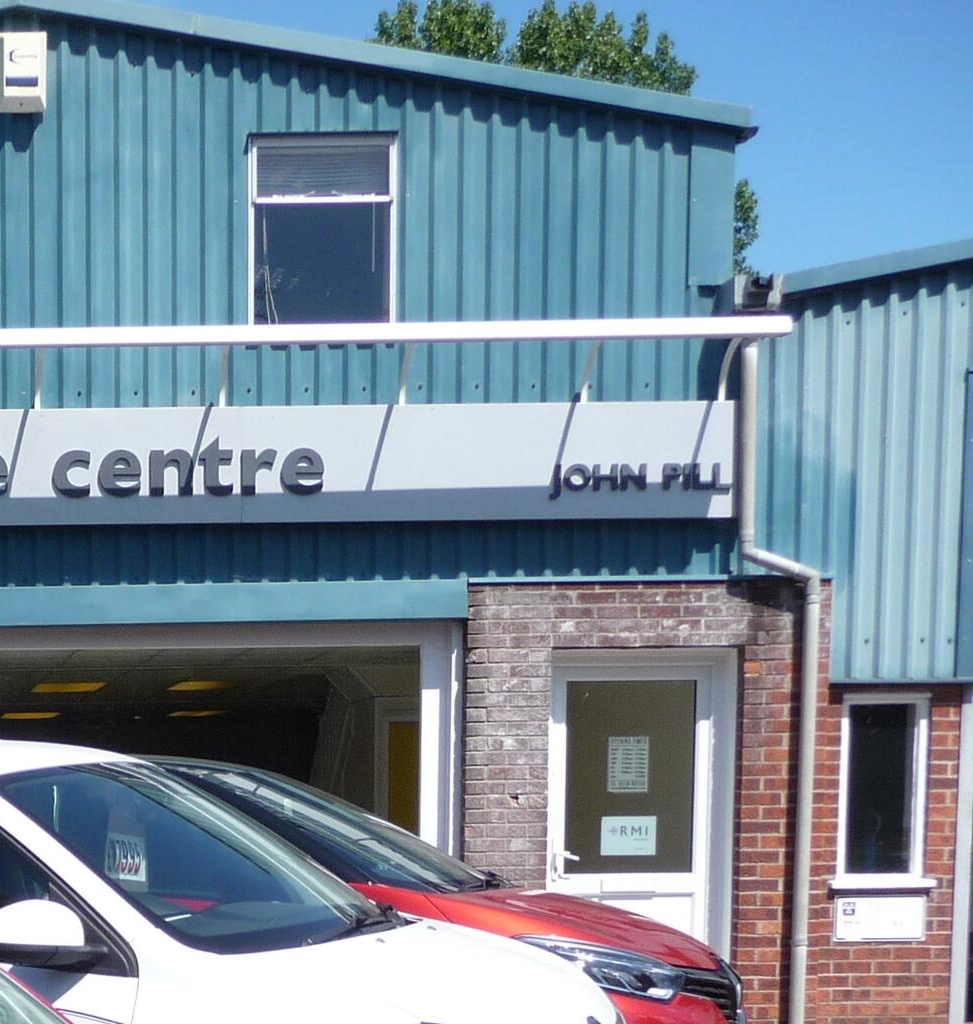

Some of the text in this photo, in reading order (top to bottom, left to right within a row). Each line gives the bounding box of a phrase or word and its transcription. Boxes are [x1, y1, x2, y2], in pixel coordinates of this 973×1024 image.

[51, 437, 325, 498] centre
[549, 462, 733, 501] JOHN PILL
